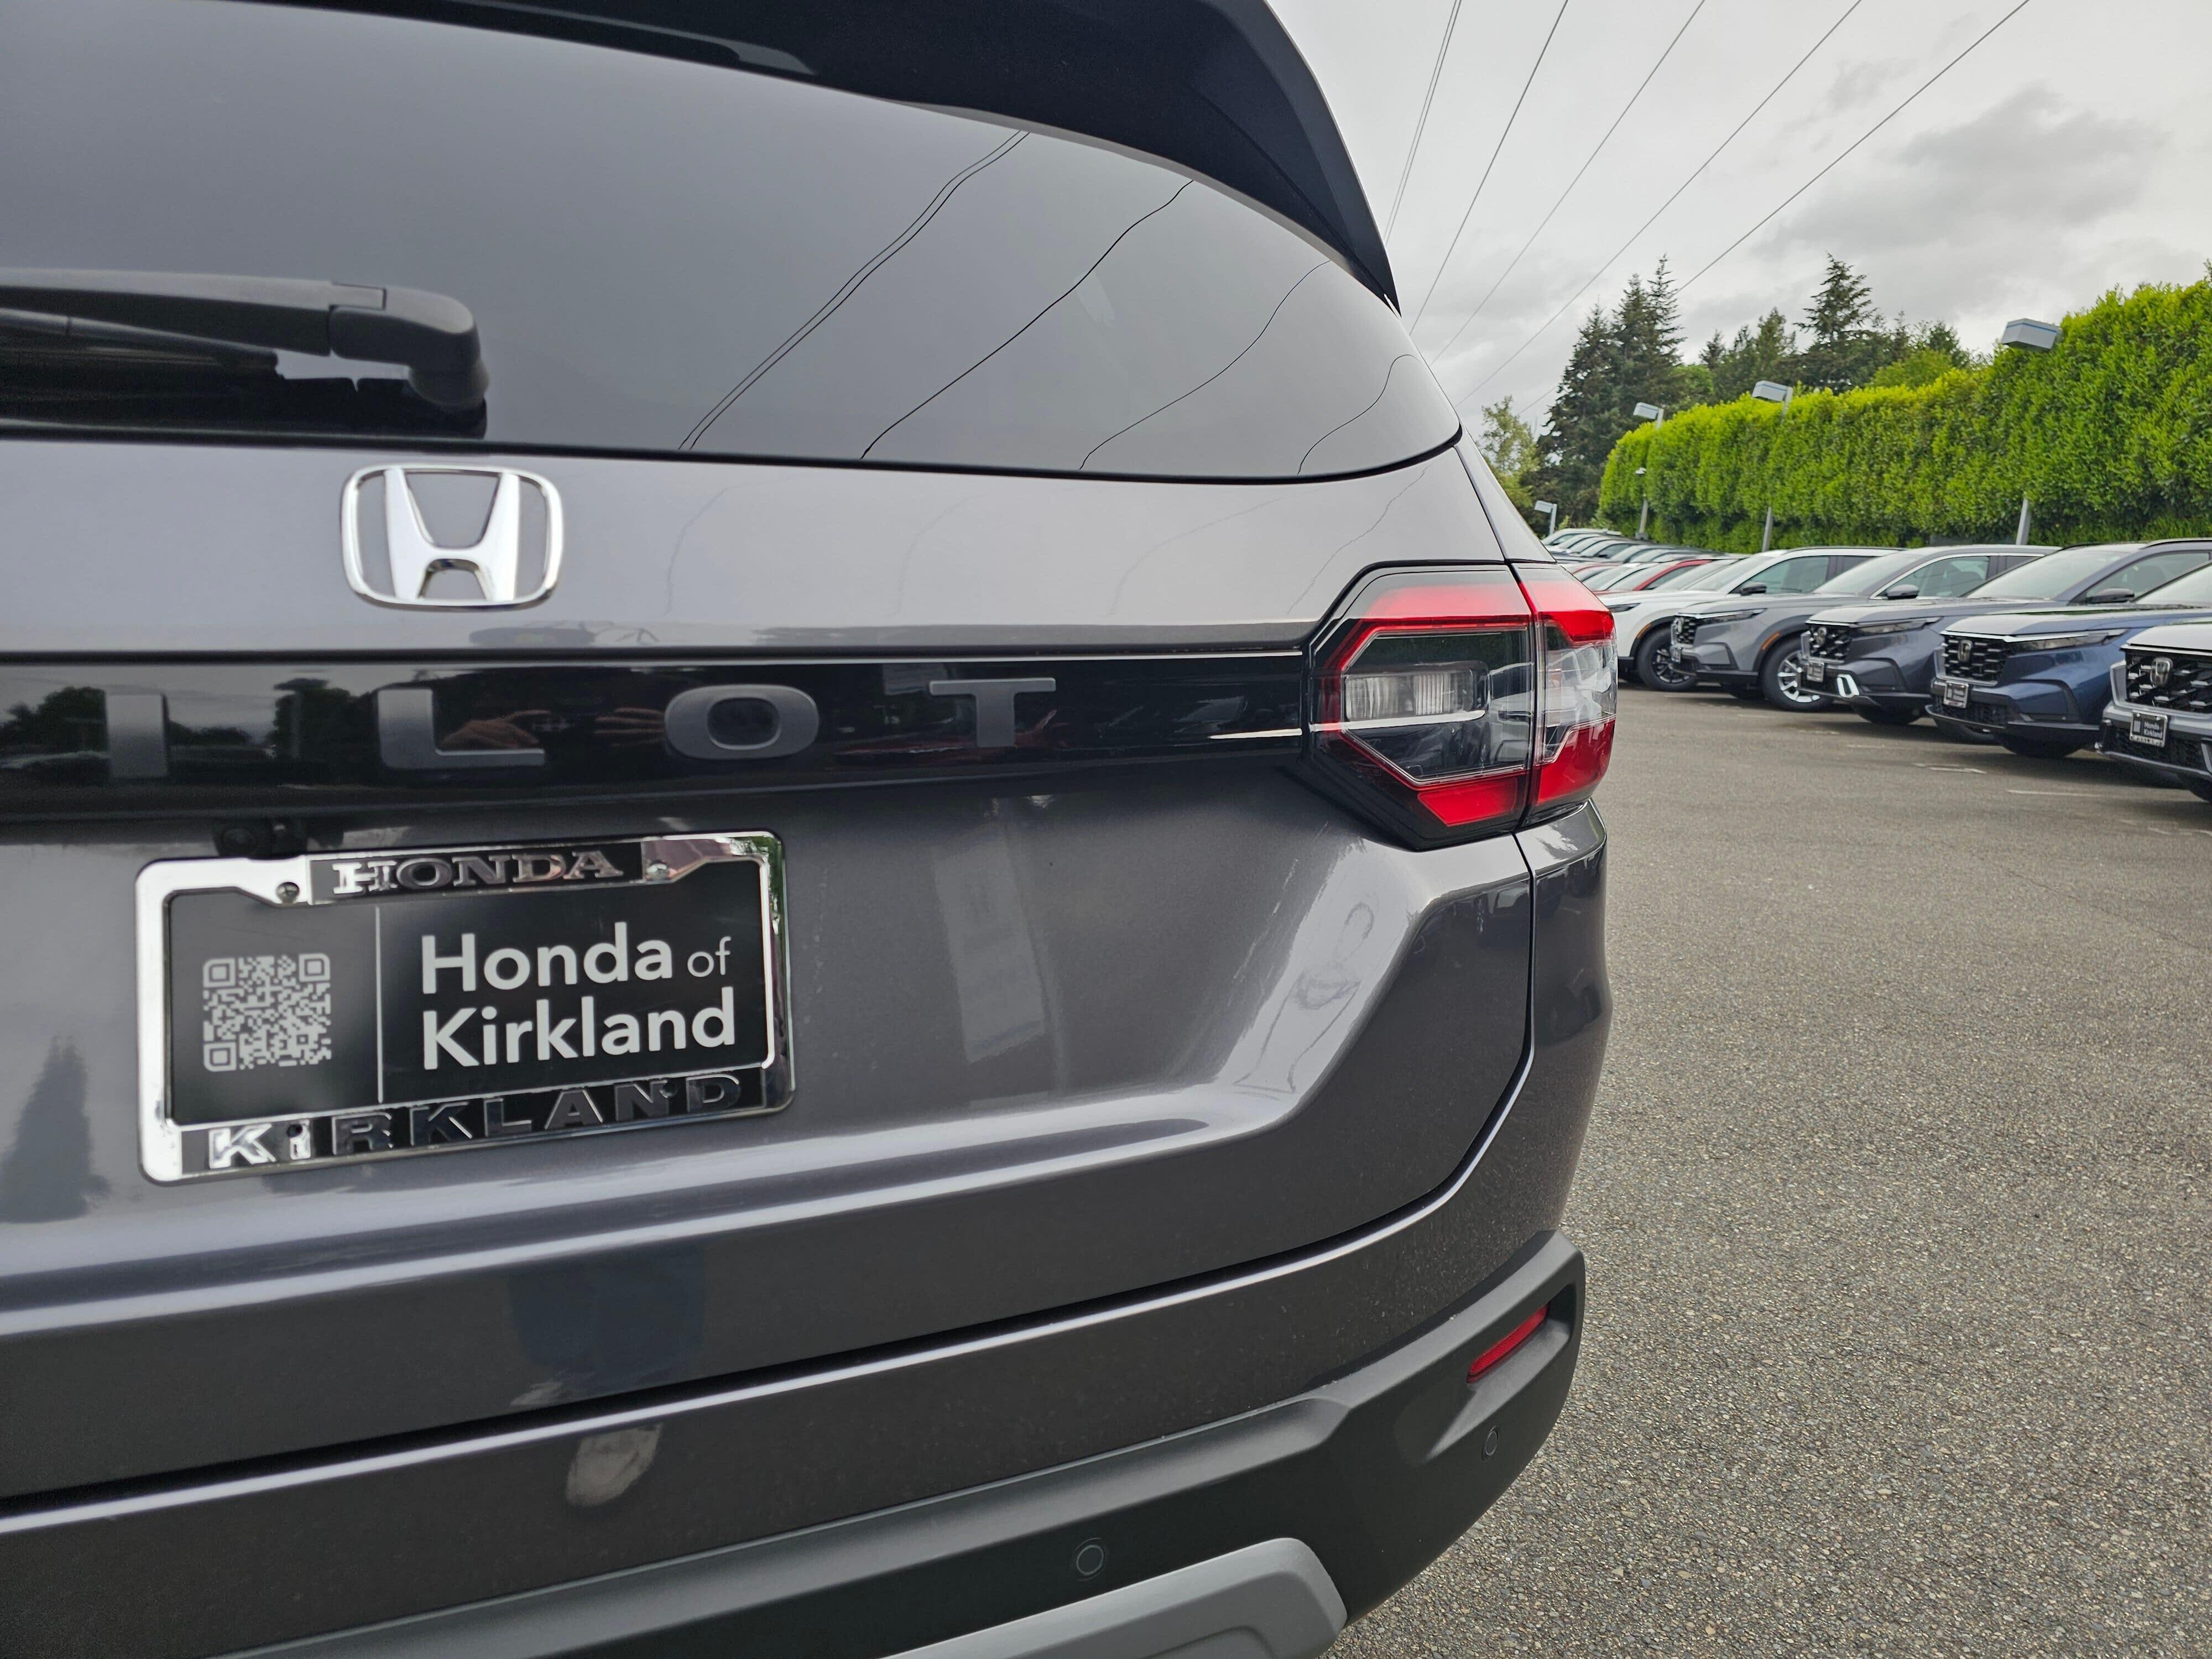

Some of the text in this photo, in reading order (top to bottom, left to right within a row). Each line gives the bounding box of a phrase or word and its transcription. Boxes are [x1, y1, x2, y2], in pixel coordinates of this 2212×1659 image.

[333, 850, 623, 894] HONDA
[422, 922, 731, 994] Honda of
[423, 987, 735, 1070] Kirkland
[208, 1074, 741, 1168] KIRKLAND
